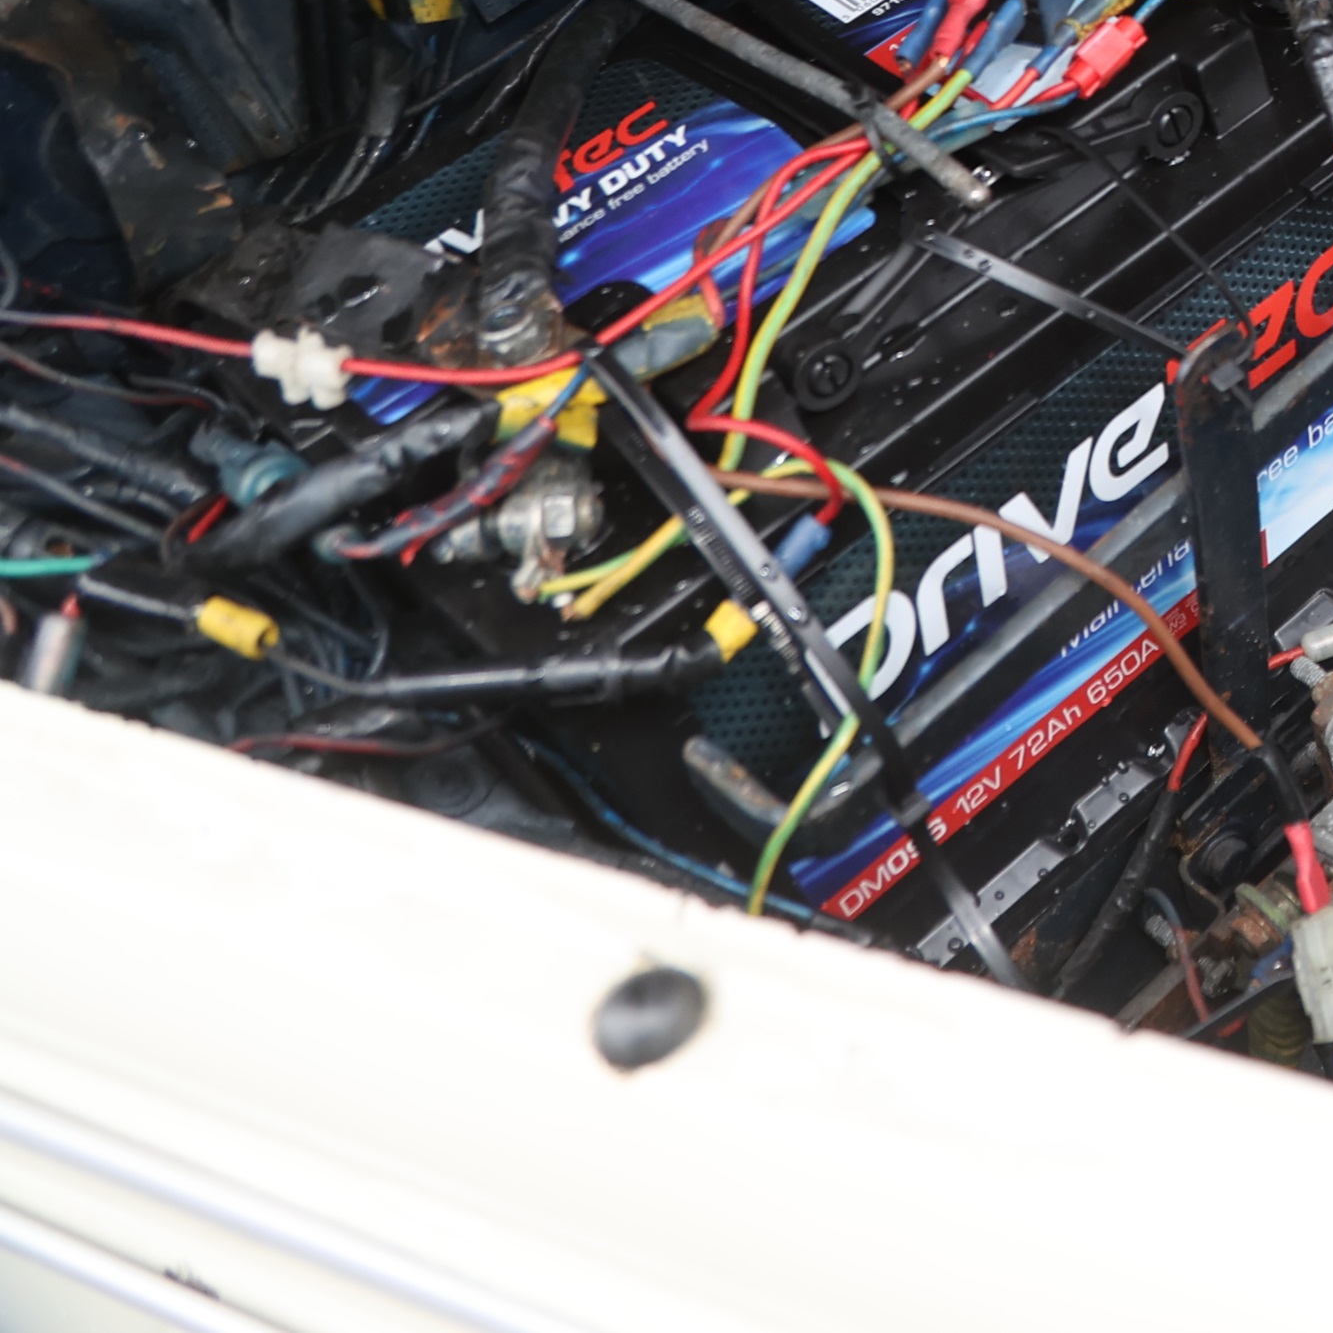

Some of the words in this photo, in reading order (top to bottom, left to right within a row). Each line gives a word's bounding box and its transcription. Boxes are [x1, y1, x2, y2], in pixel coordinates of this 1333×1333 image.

[598, 124, 687, 197] DUTY
[607, 183, 645, 210] free
[646, 138, 709, 185] battery
[1256, 445, 1298, 493] ree
[954, 766, 1002, 816] 12V
[1008, 705, 1083, 771] 72Ah
[1086, 638, 1159, 705] 650A
